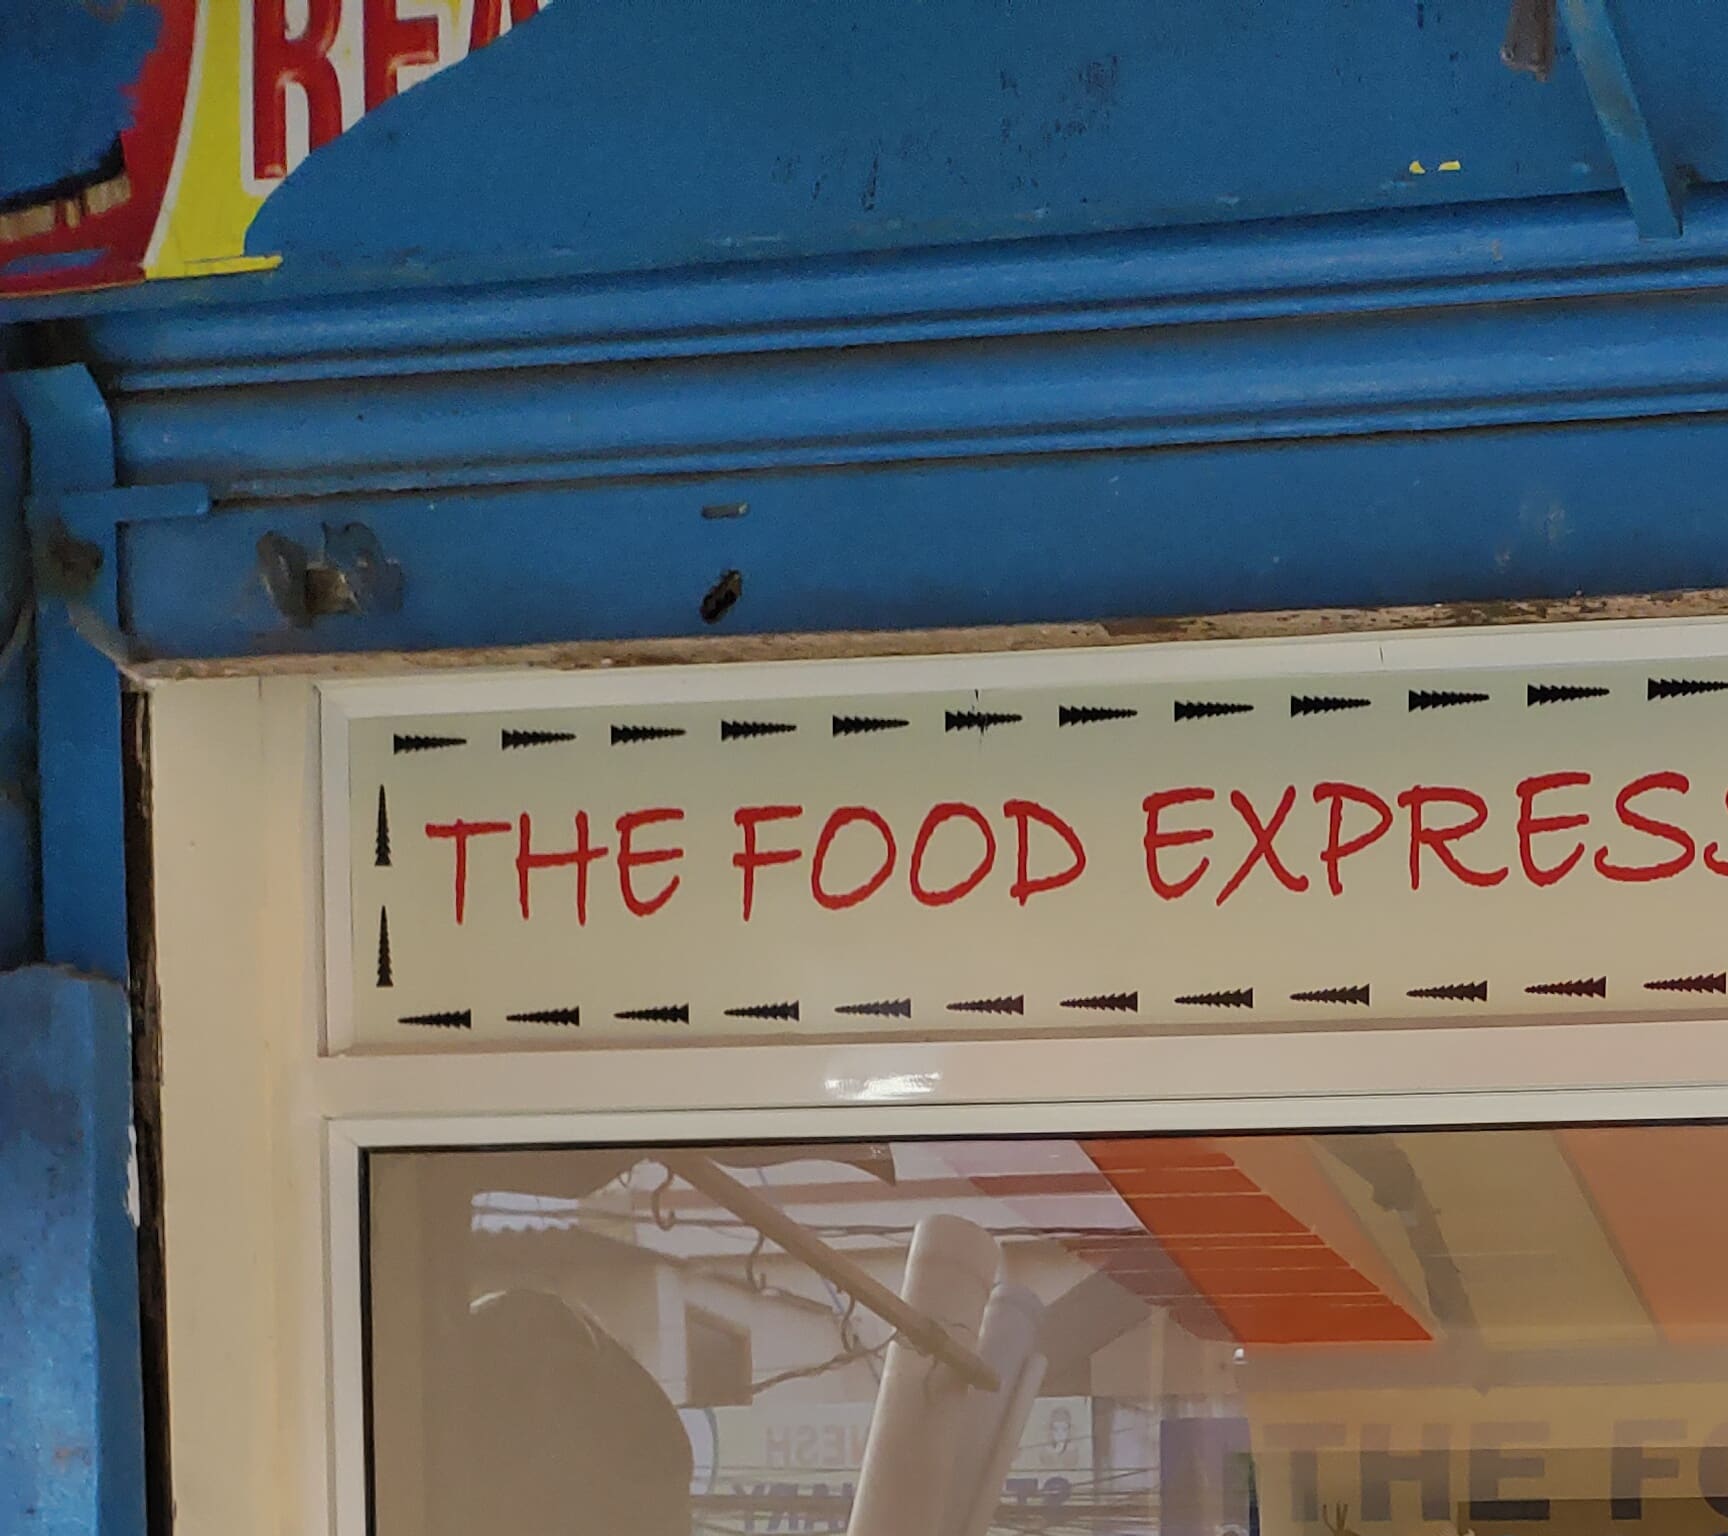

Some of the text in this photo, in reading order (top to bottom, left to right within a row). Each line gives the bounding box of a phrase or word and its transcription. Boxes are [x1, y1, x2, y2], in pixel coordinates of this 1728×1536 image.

[424, 806, 686, 926] THE
[733, 801, 1086, 921] FOOD
[1262, 1421, 1551, 1523] THE
